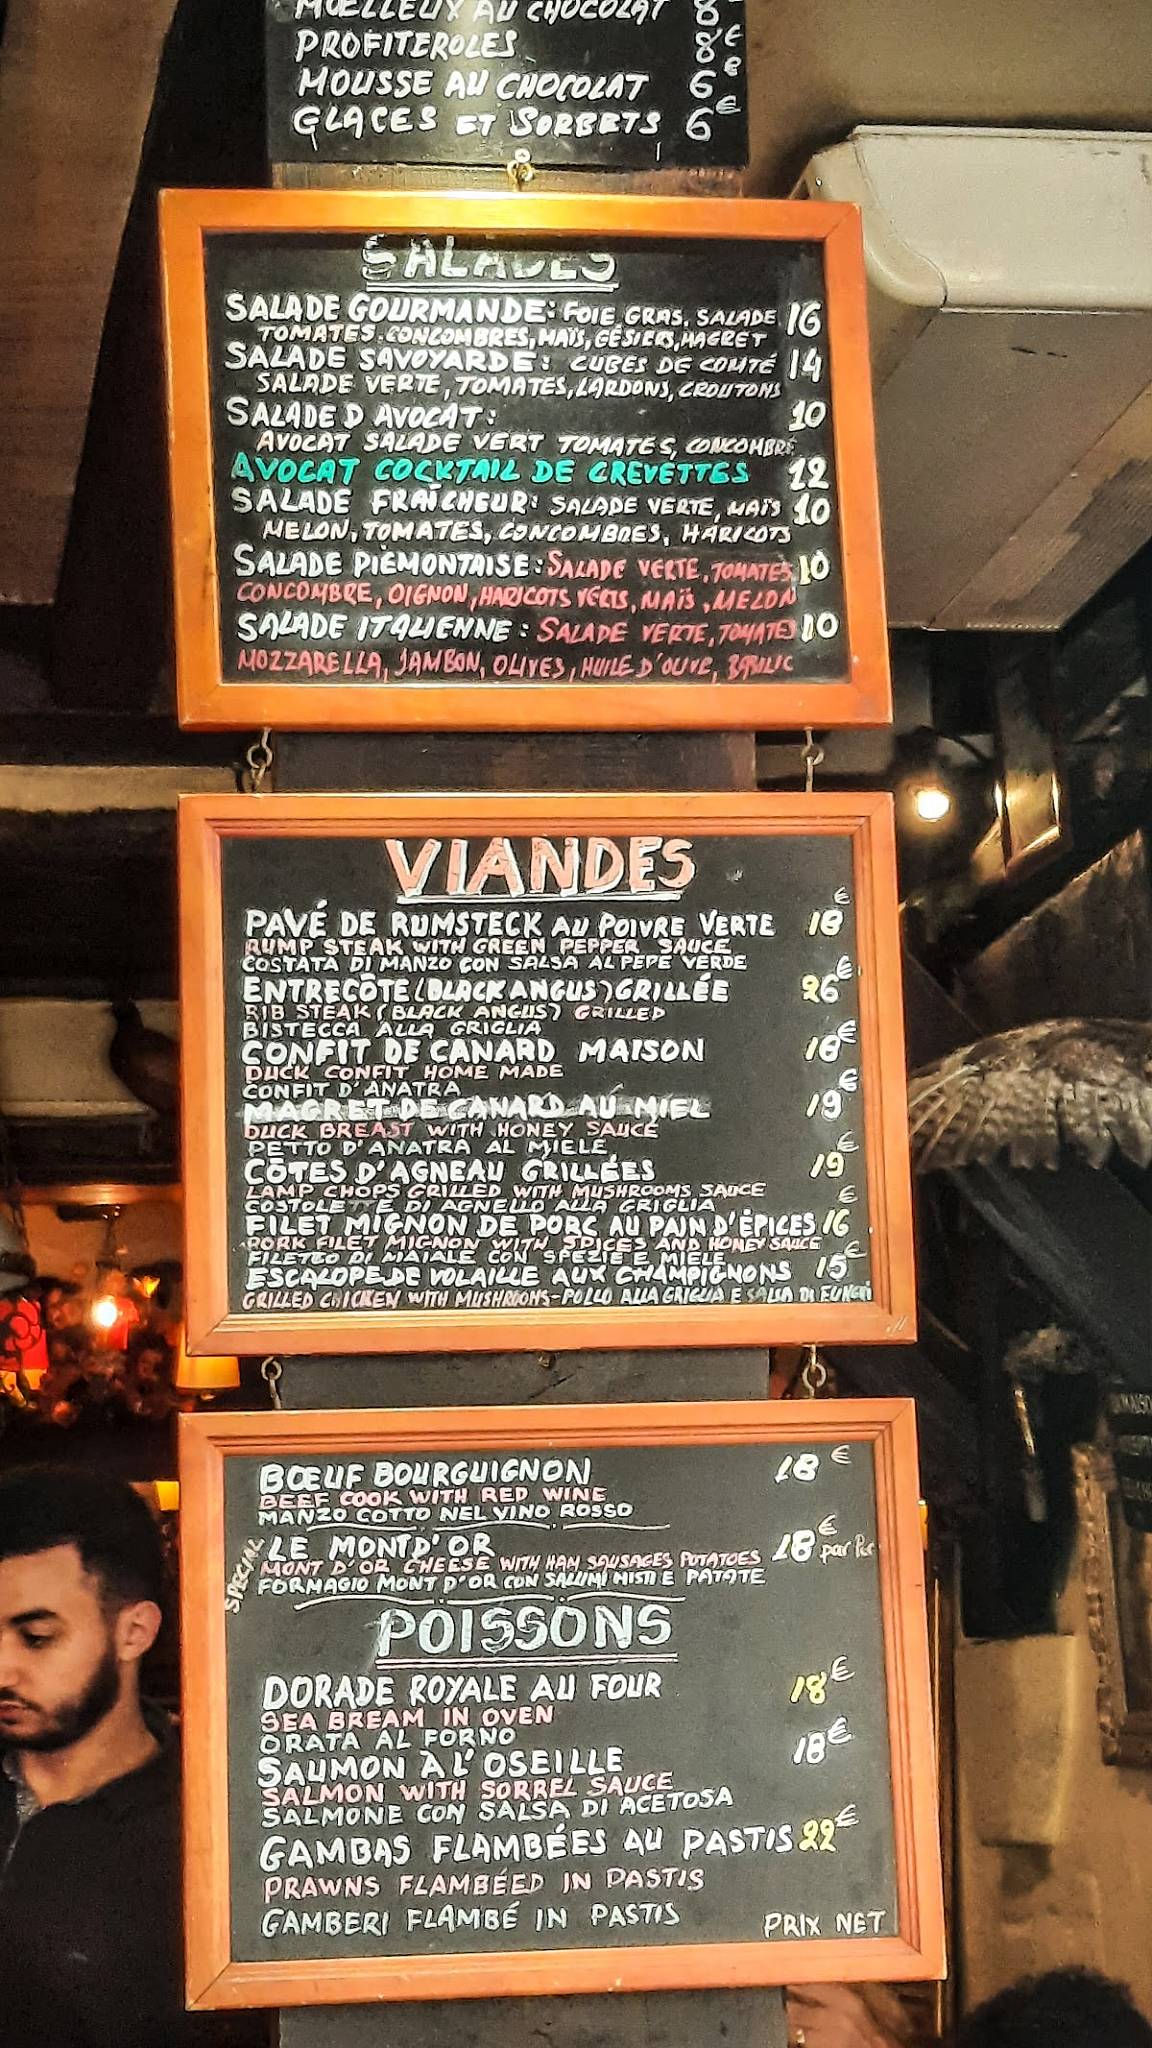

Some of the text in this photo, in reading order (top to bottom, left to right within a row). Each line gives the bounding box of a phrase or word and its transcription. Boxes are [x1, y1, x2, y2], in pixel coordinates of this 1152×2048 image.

[527, 0, 671, 25] CHOCOLAT
[295, 29, 517, 62] PROFITEROLES
[299, 69, 650, 101] MOUSSE AU CHOCOLAT
[293, 105, 661, 138] GLACES ET SORBETS
[225, 292, 777, 327] SALADE GOURMANDE: FOIE SALADE
[225, 341, 822, 382] SALADE SAVOYARDE: CUBES DE COMTÉ 14
[257, 373, 781, 399] SALADE CROUTONS
[225, 397, 826, 431] SALADE AVOCAT: 10
[257, 431, 545, 453] AVOCAT SALADE VERT
[231, 451, 829, 491] AVOCAT COCKTAIL DE 12
[231, 486, 830, 525] SALADE SALADE 10
[682, 524, 791, 543] HARICOTS
[233, 543, 794, 585] SALADE SALADE TOMATES
[237, 610, 627, 643] SALADE SALADE
[385, 836, 696, 898] VIANDES
[246, 899, 774, 939] PAVÉ DE RUMSTECK AU POIVRE VERTE
[246, 938, 731, 956] RUMP STEAK WITH GREEN PEPPER SAUCE
[242, 955, 747, 973] COSTATA DI MANZO CON VERDE
[246, 1005, 665, 1021] RIB STEAK GRILLED
[243, 1021, 542, 1039] BISTECCA ALLA GRIGLIA
[242, 1038, 705, 1067] CONFIT DE CANARD MAISON
[246, 1065, 564, 1083] DUCK CONFIT HOME MADE
[243, 1083, 330, 1099] CONFIT
[243, 1094, 710, 1122] MAGRET DE CANARD MIEL
[244, 1122, 659, 1139] DUCK BREAST WITH HONEY SAUCE
[248, 1139, 515, 1157] PETTO AL
[324, 1184, 691, 1199] CHOPS GRILLED WITH MUSHROOMS
[405, 1200, 606, 1213] DI AGNELLO ALLA
[246, 1215, 706, 1238] FILET MIGNON DE PORC AU PAIN
[316, 1236, 647, 1250] FILET MIGNON WITH SPICES
[661, 1251, 725, 1266] MIELE
[552, 1261, 792, 1286] AUX CHAMPIGNONS
[374, 1457, 591, 1488] BOURGUIGNON
[259, 1487, 607, 1509] BEEF COOK WITH RED WINE
[258, 1503, 633, 1526] MANZO COTTO NEL VINO ROSSO
[268, 1535, 308, 1561] LE
[404, 1555, 540, 1574] CHEESE WITH
[376, 1575, 440, 1594] MONT
[376, 1603, 672, 1657] POISSONS
[263, 1672, 662, 1710] DORADE ROYALE AU FOUR
[261, 1705, 554, 1733] SEA BREAM IN OVEN
[260, 1727, 516, 1754] ORATA AL FORNO
[258, 1755, 405, 1788] SAUMON
[262, 1770, 674, 1806] SALMON WITH SORREL SAUCE
[261, 1786, 733, 1828] SALMONE CON SALSA DI ACETOSA
[260, 1824, 793, 1872] GAMBAS AU PASTIS
[264, 1867, 705, 1904] PRAWNS PASTIS
[261, 1901, 680, 1938] GAMBERI IN PASTIS
[765, 1910, 887, 1937] PRIX NET
